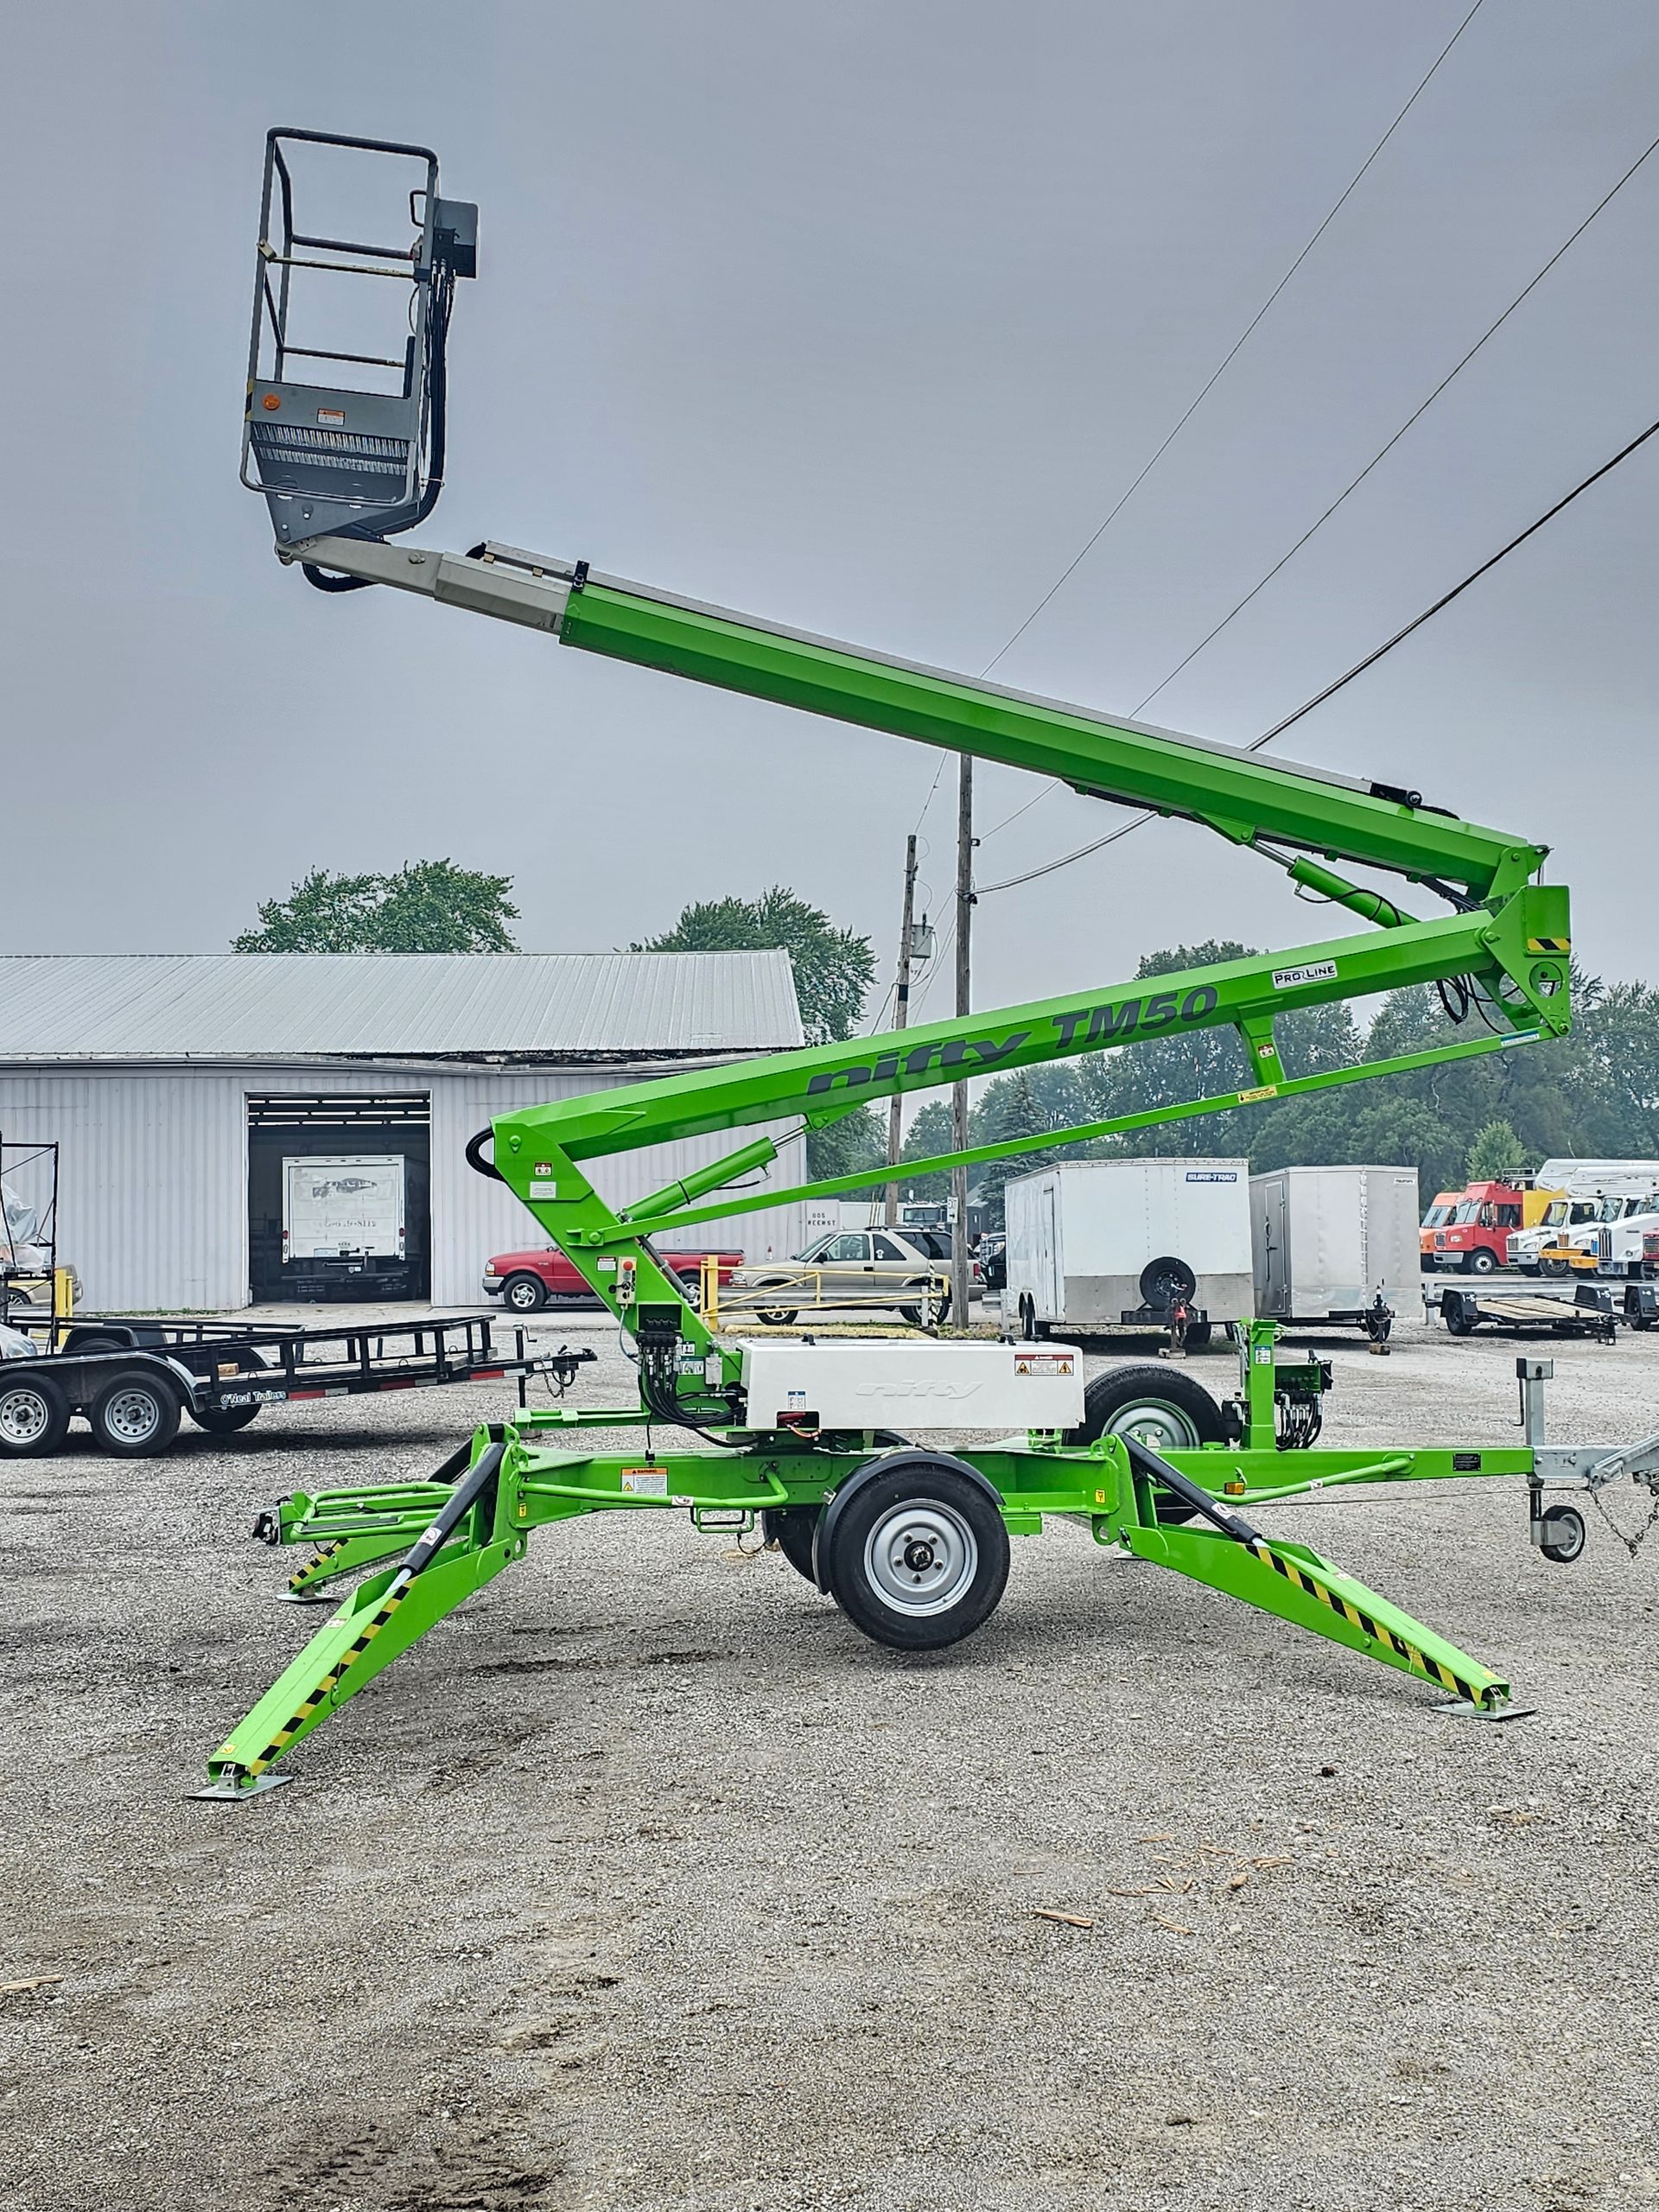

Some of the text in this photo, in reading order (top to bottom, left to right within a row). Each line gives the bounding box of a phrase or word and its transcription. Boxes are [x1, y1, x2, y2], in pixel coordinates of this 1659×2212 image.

[1274, 965, 1336, 984] PRO LINE
[1052, 986, 1218, 1049] TM50
[806, 1031, 1033, 1096] nifty
[855, 1380, 983, 1399] nifty
